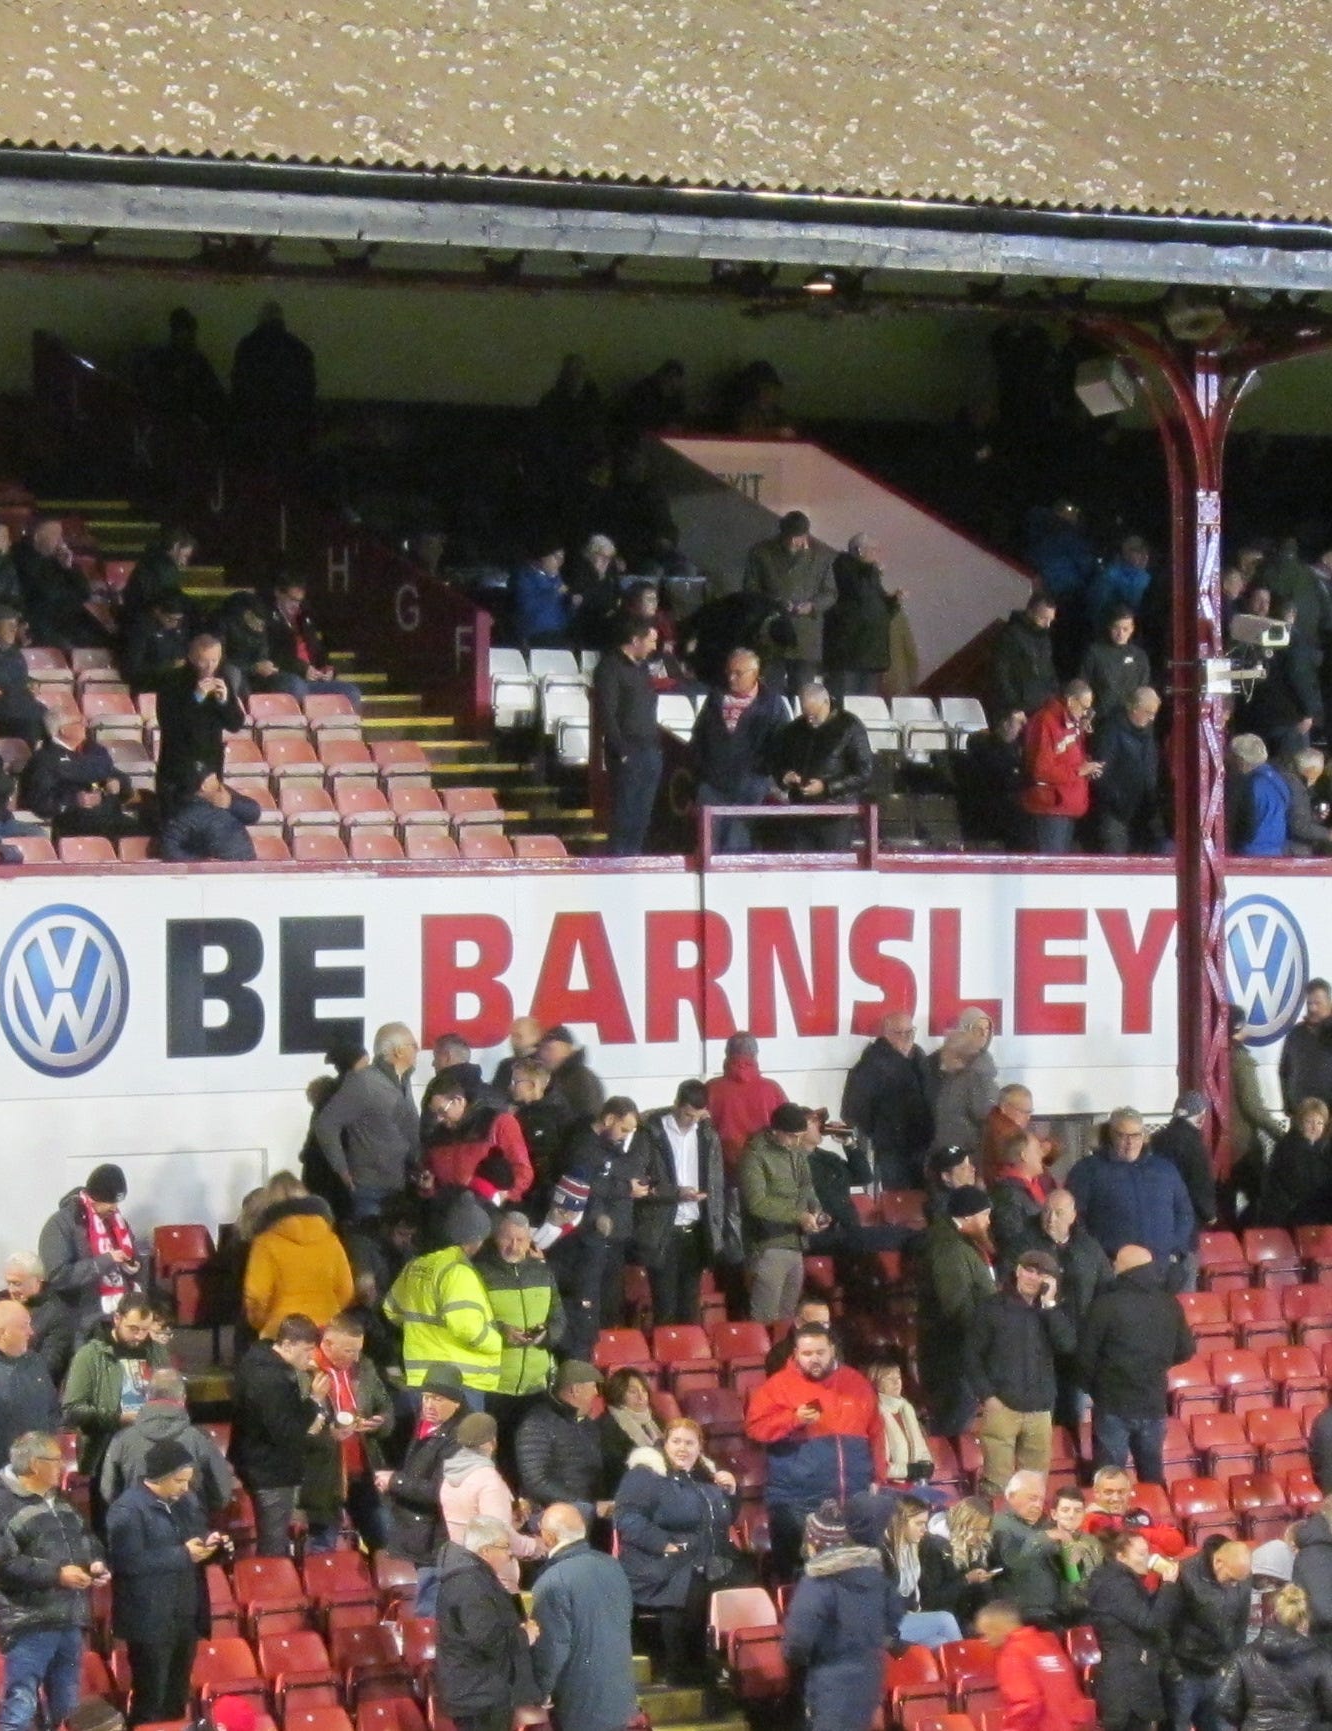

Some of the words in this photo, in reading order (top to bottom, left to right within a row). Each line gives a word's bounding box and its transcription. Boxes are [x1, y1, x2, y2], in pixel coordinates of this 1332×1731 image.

[326, 545, 350, 593] H
[394, 584, 421, 632] G
[453, 625, 474, 674] F
[1, 915, 124, 1066] VW
[165, 915, 365, 1059] BE
[420, 904, 1178, 1049] BARNSLEY
